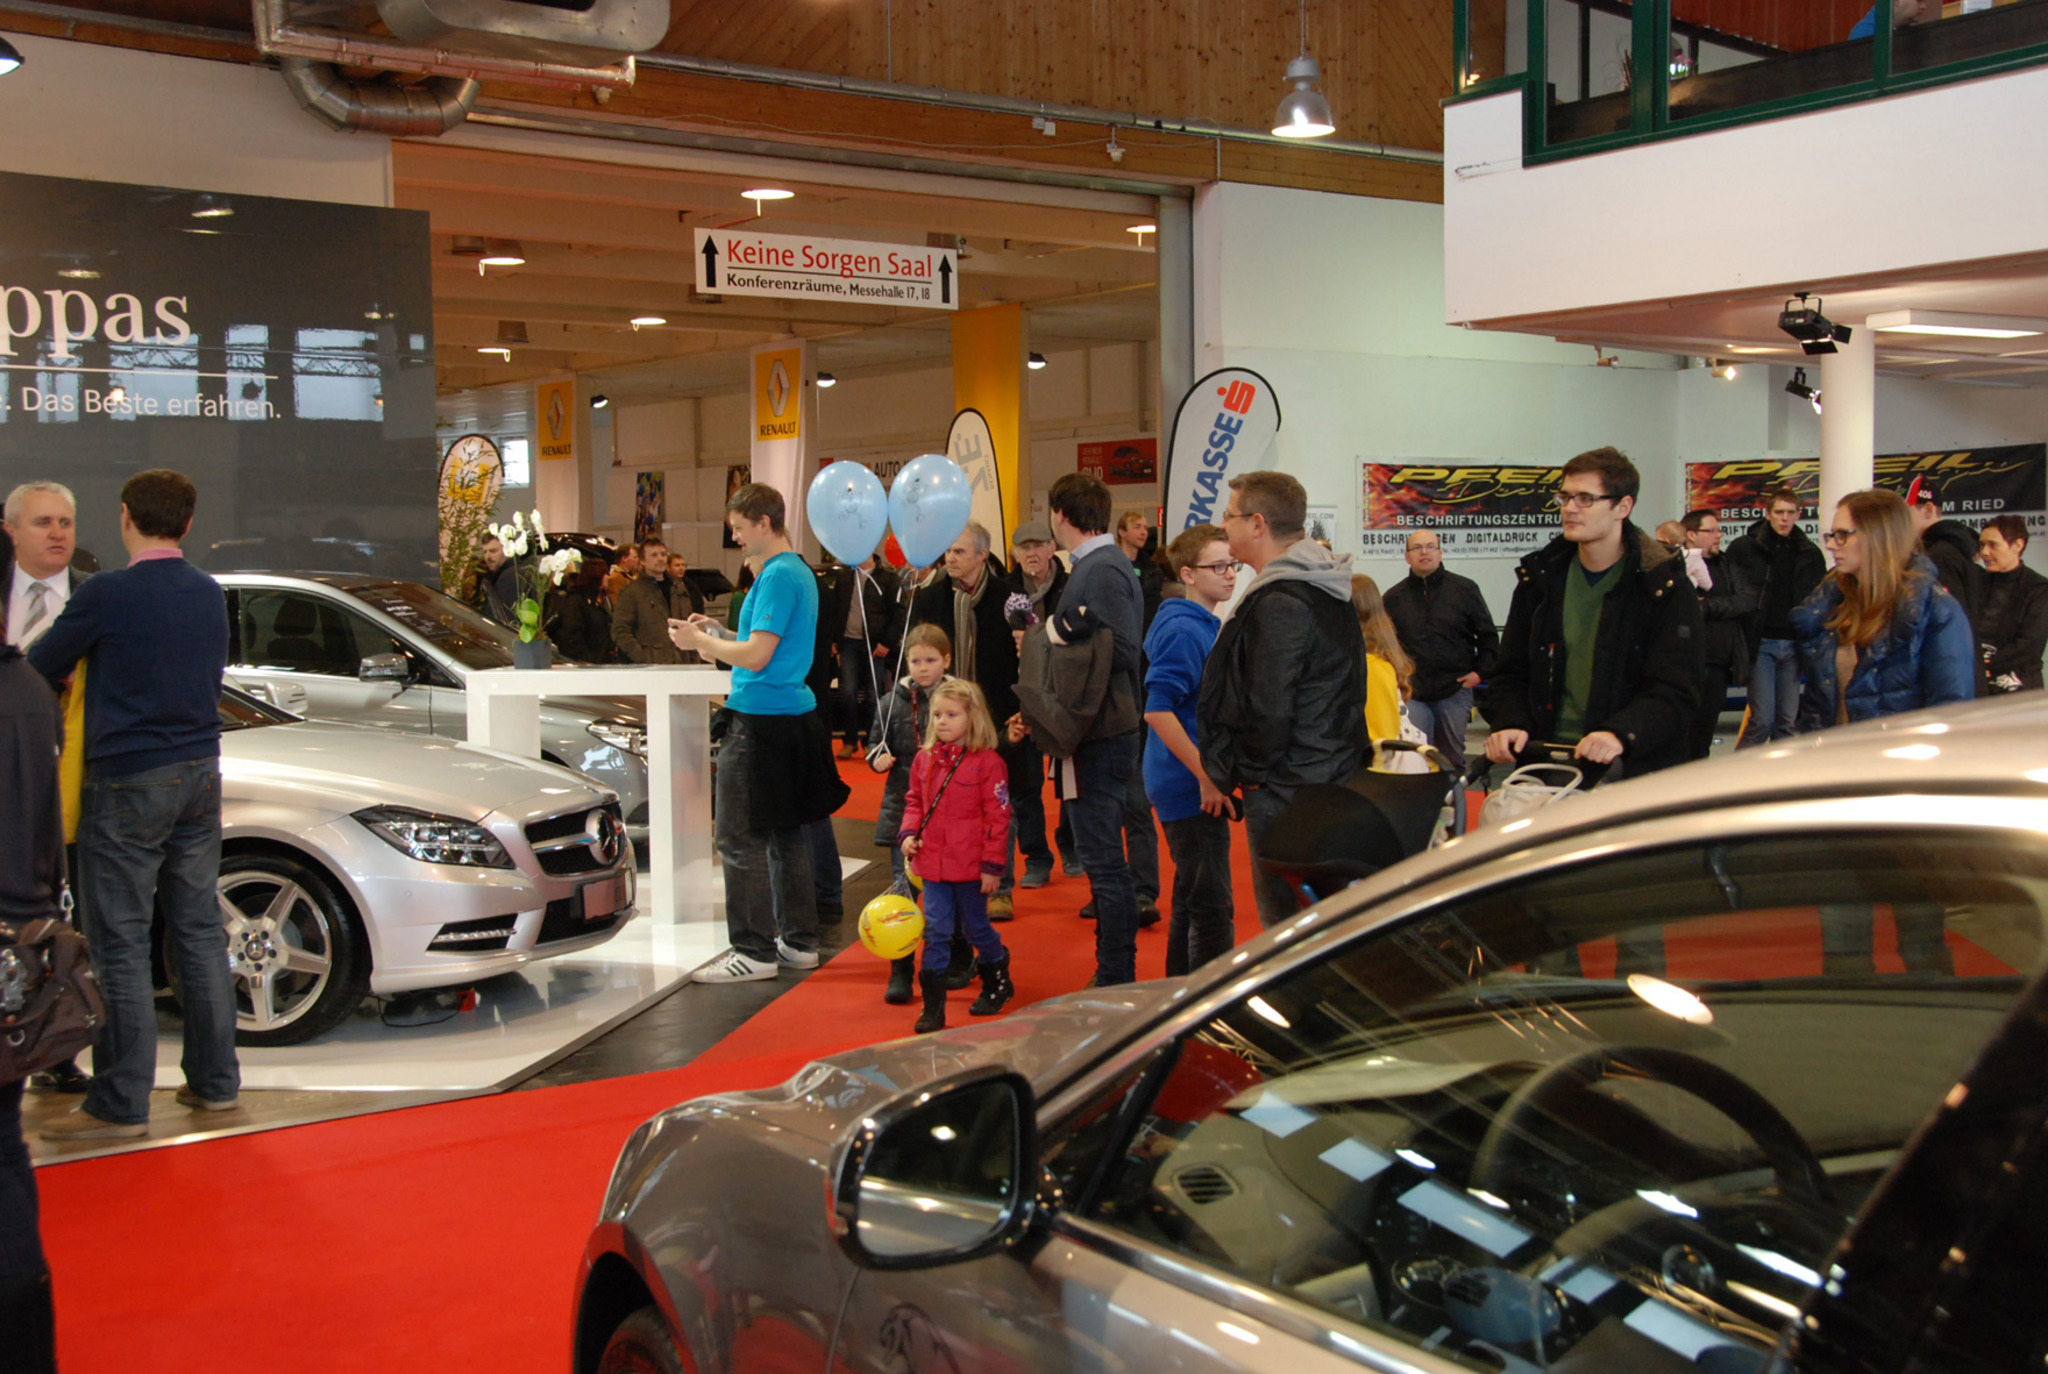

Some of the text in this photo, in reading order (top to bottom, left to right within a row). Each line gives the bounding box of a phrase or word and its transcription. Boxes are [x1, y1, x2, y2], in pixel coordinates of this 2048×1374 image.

[727, 239, 932, 278] Keine Sorgen Saal
[727, 272, 931, 301] Konferenzräume, Messehalle 17, 18
[22, 386, 75, 413] Das
[85, 389, 159, 415] Beste
[167, 393, 282, 419] erfahren.
[760, 421, 796, 436] RENAULT
[874, 461, 901, 478] AUTO
[1184, 412, 1243, 529] RKASSE
[1389, 467, 1564, 485] PFEI
[1962, 498, 2005, 511] RIED
[1396, 513, 1562, 527] BESCHRIFTUNGSZENTRU
[1466, 532, 1537, 544] DIGITALDRUCK
